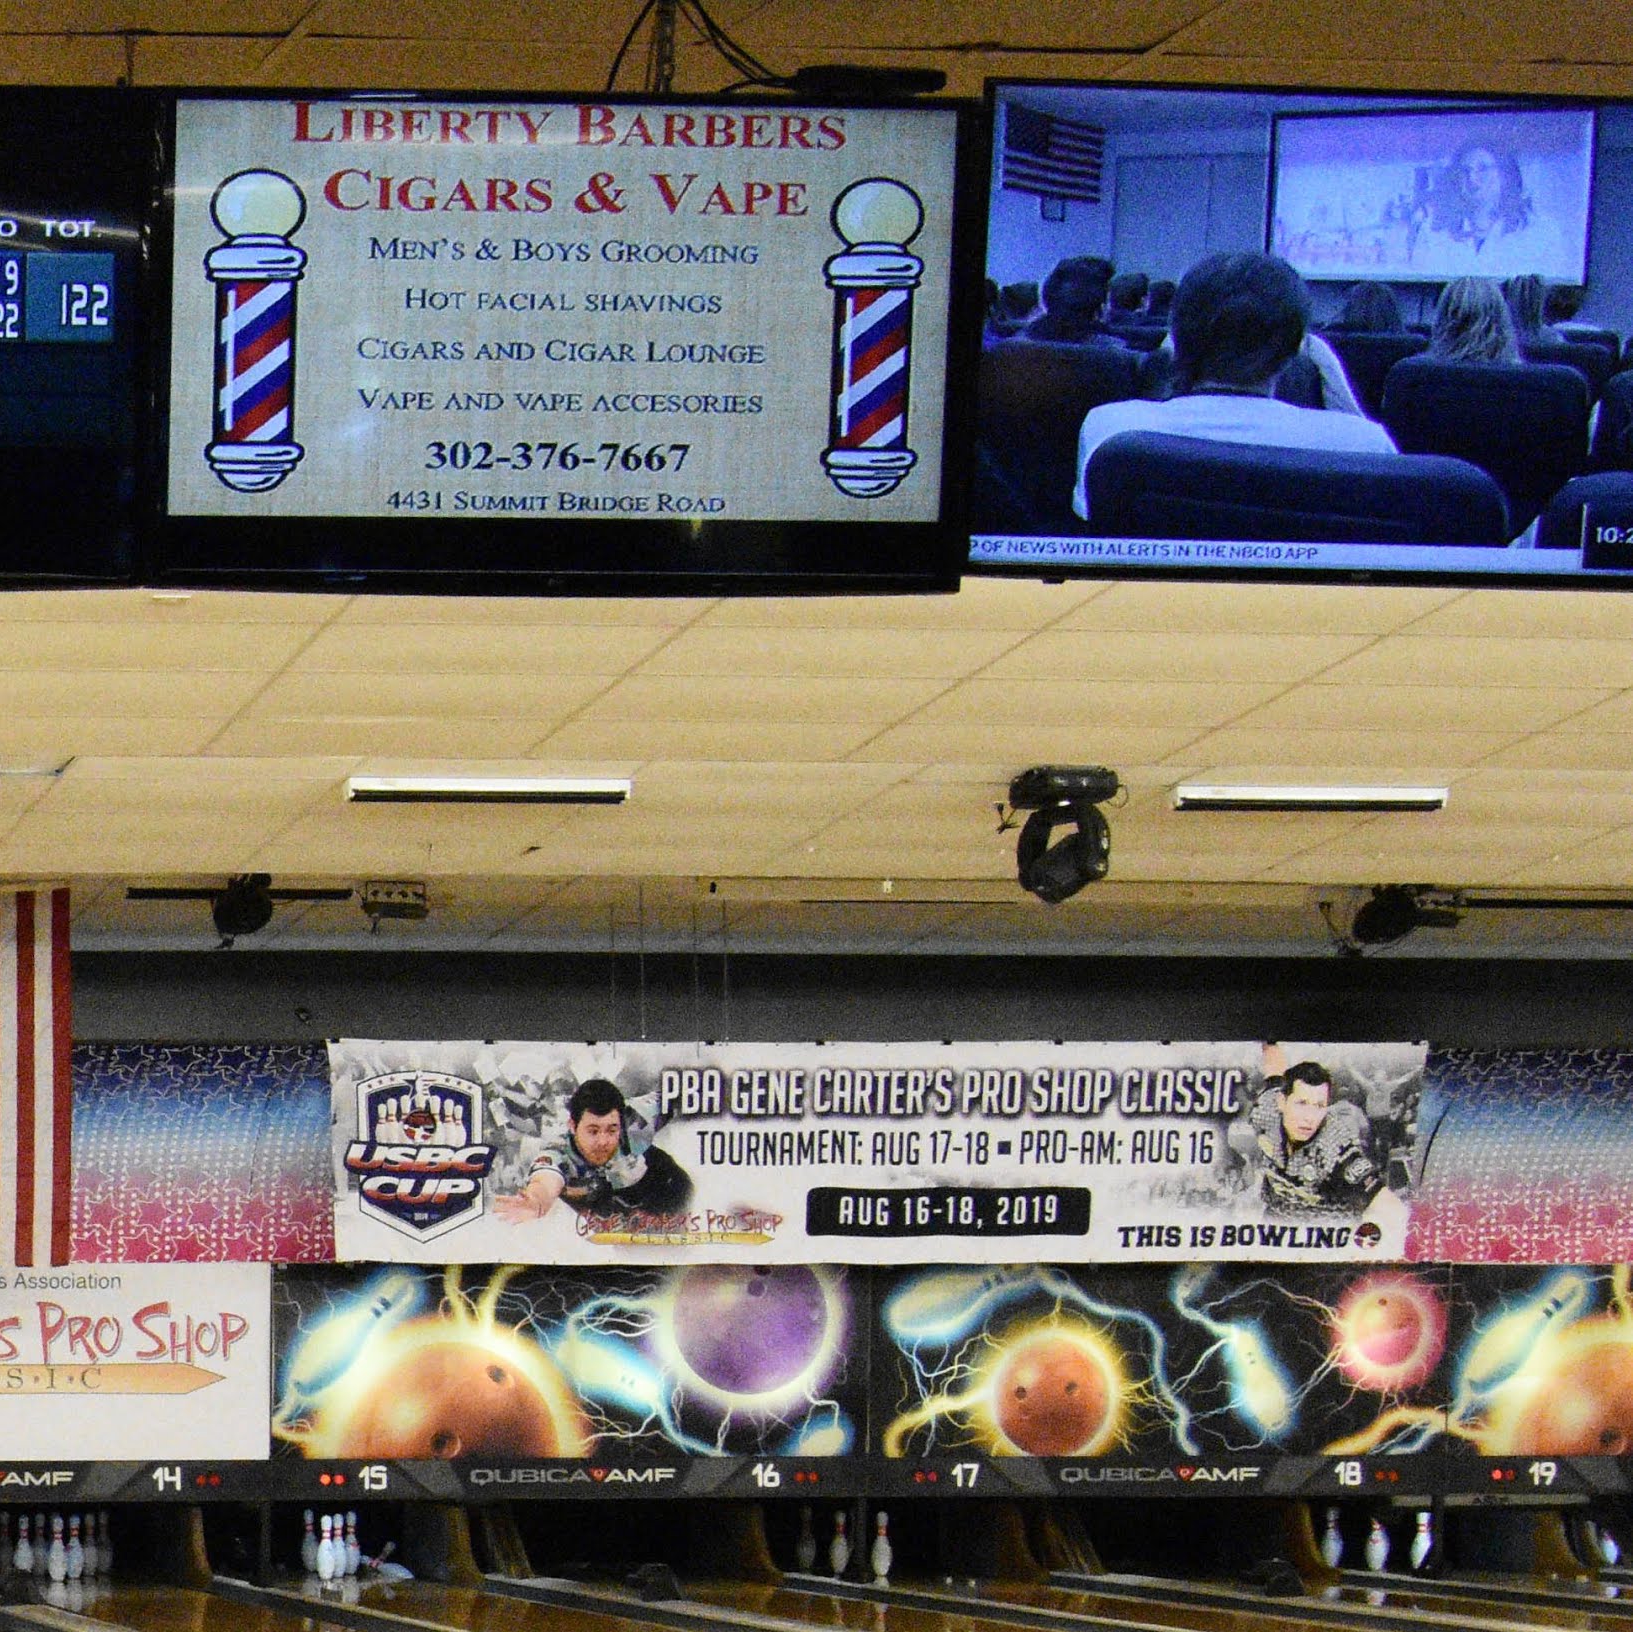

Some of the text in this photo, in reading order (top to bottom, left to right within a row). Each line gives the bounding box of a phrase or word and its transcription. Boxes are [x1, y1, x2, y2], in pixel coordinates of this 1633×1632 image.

[291, 101, 847, 150] LIBERTY BARBERS
[324, 169, 808, 216] CIGARS & VAPE
[369, 237, 759, 264] MEN'S & BOYS GROOMING
[62, 284, 108, 325] 122
[406, 288, 722, 314] HOT FACIAL SHAVINGS
[357, 338, 765, 363] CIGARS AND CIGAR LOUNGE
[358, 389, 763, 414] VAPE AND VAPE ACCESORIES
[425, 442, 690, 471] 302-376-7667
[387, 491, 725, 512] 4431 SUMMIT BRIDGE ROAD
[660, 1069, 1242, 1115] PBA GENE CARTER'S PRO SHOP CLASSIC
[346, 1144, 489, 1172] USBC
[697, 1130, 1213, 1166] TOURNAMENT: AUG 17-18 PRO-AM: AUG 16
[363, 1178, 475, 1204] CUP
[839, 1195, 1057, 1229] AUG 16-18, 2019
[1118, 1225, 1349, 1249] THIS IS BOWLING
[13, 1272, 121, 1290] Association
[36, 1301, 122, 1364] PRO
[135, 1302, 249, 1363] SHOP
[0, 1471, 74, 1486] AMF
[151, 1466, 181, 1492] 14
[357, 1465, 388, 1491] 15
[604, 1467, 676, 1483] AMF
[750, 1463, 780, 1489] 16
[950, 1462, 980, 1489] 17
[1334, 1460, 1362, 1487] 18
[1527, 1460, 1557, 1487] 19
